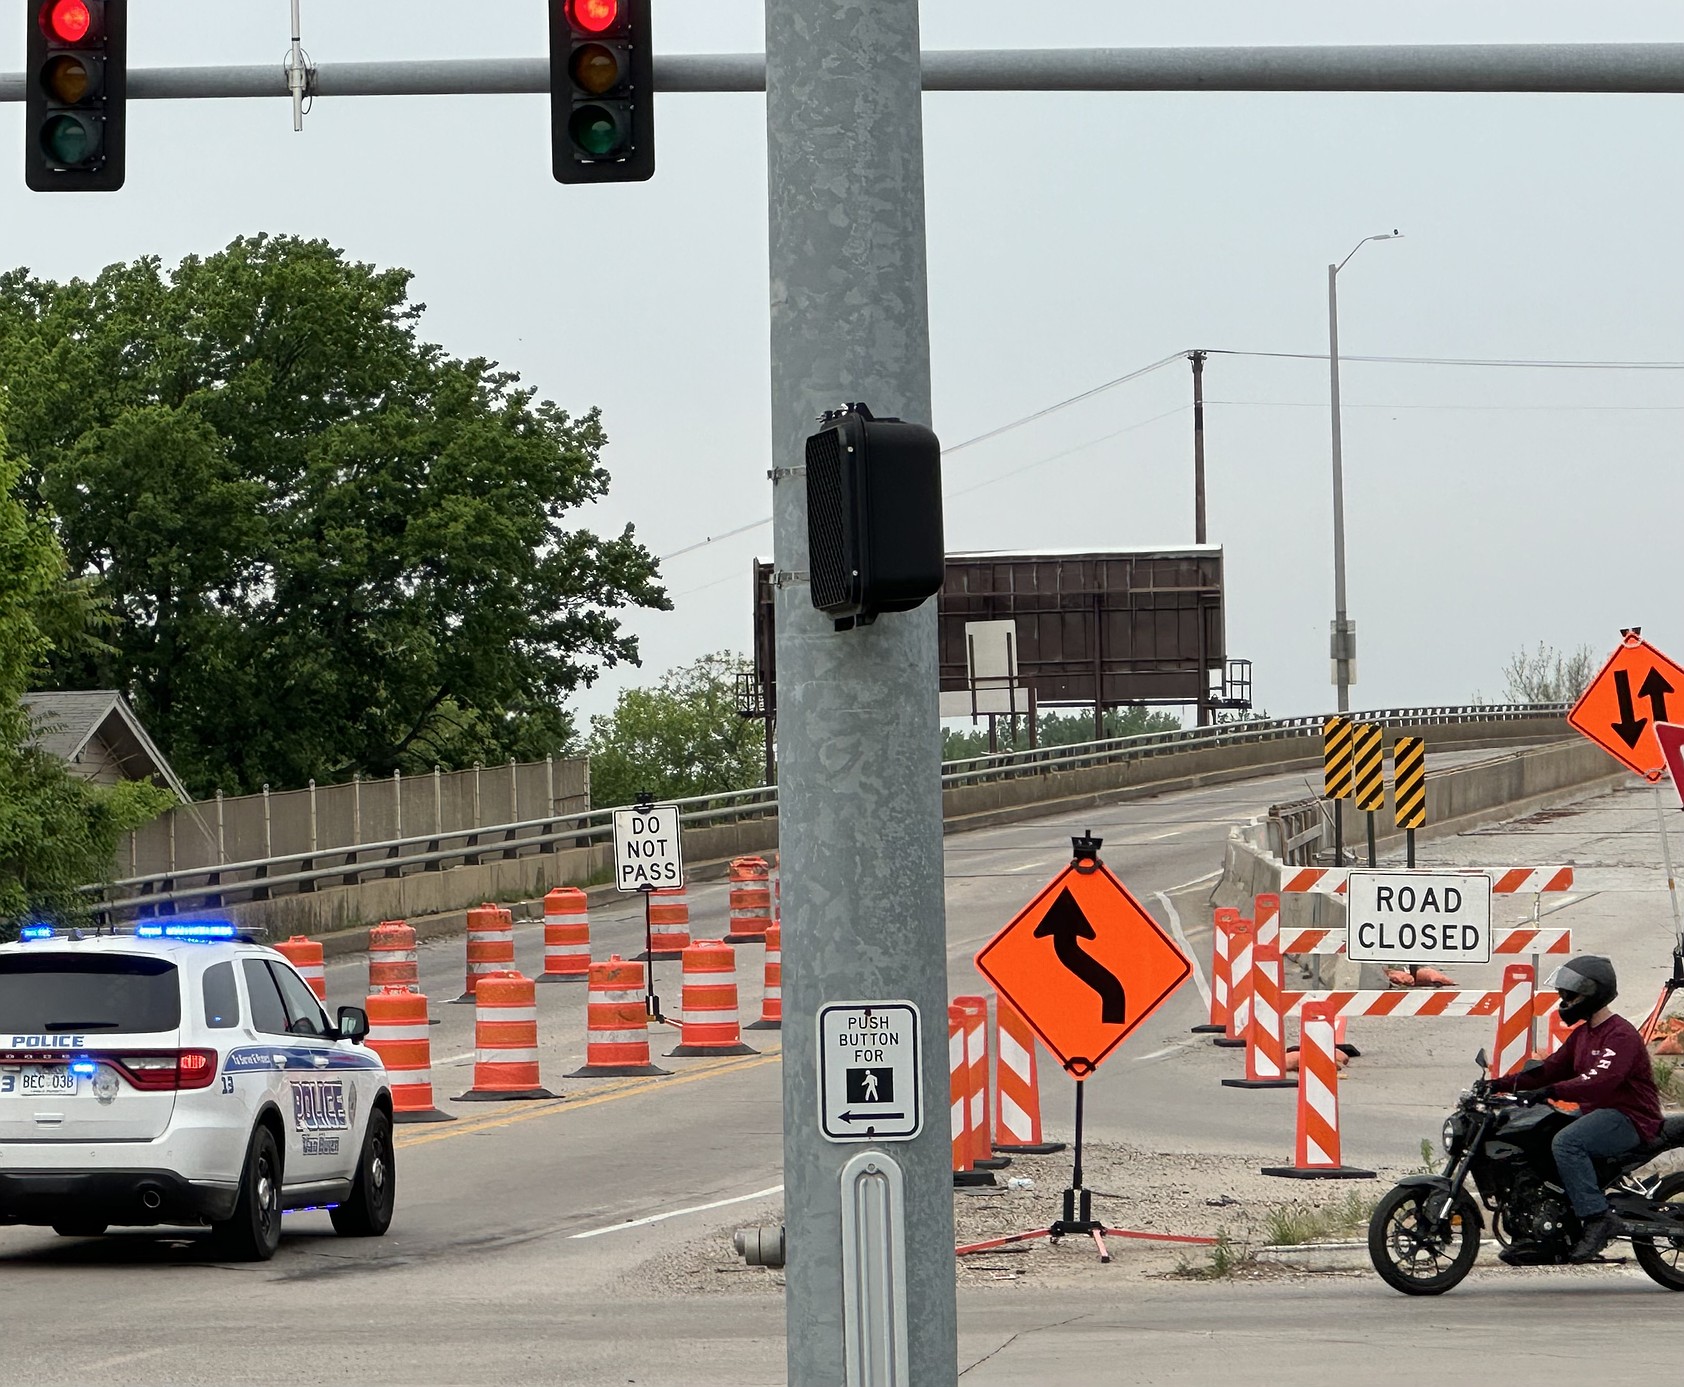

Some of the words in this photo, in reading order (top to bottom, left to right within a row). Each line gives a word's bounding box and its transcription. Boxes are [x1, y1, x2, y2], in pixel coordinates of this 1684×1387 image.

[632, 816, 660, 835] DO
[627, 839, 668, 859] NOT
[622, 862, 676, 883] PASS
[1376, 886, 1462, 913] ROAD
[1358, 922, 1480, 950] CLOSED
[848, 1016, 889, 1030] PUSH
[12, 1035, 85, 1048] POLICE
[839, 1032, 899, 1047] BUTTON
[854, 1049, 884, 1063] FOR
[23, 1074, 45, 1089] BEC
[221, 1076, 234, 1095] 13
[289, 1080, 348, 1132] POLICE
